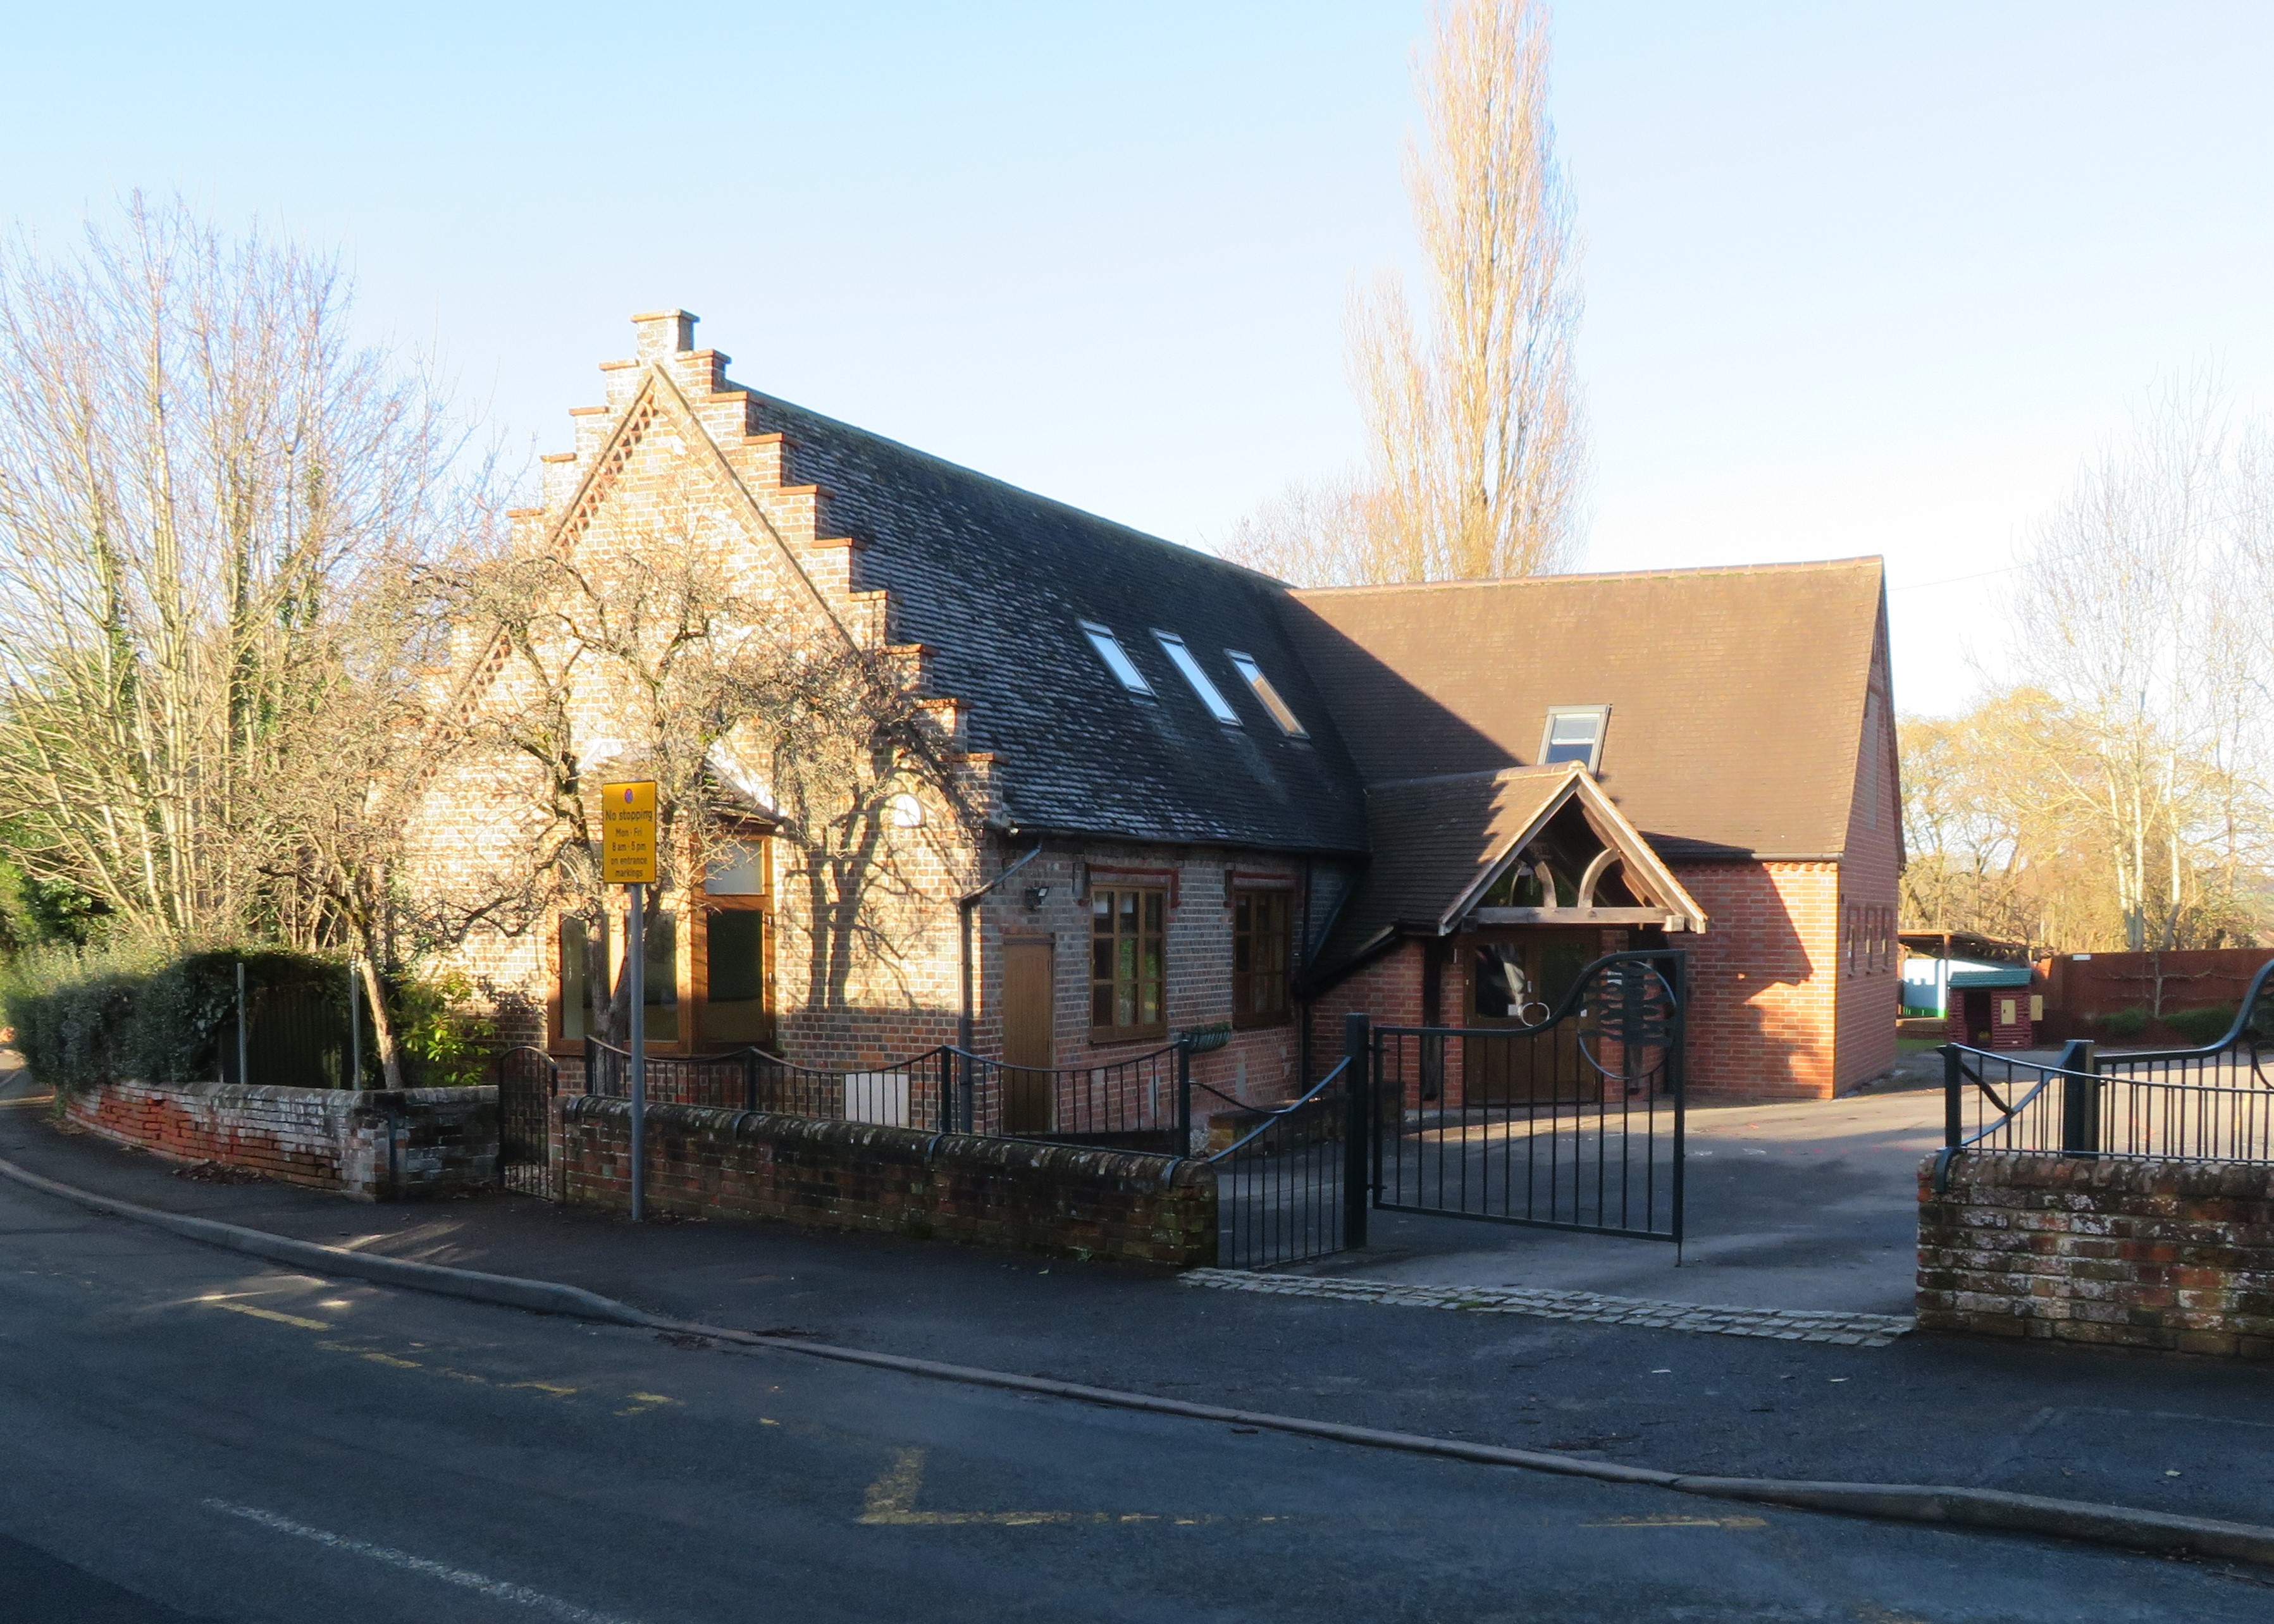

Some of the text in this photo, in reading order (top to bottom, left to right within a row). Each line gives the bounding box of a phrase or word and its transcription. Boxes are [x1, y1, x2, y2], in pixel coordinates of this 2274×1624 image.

[605, 809, 652, 821] No stopping
[615, 828, 629, 837] Mon
[634, 827, 642, 836] Fri
[615, 869, 643, 878] markings
